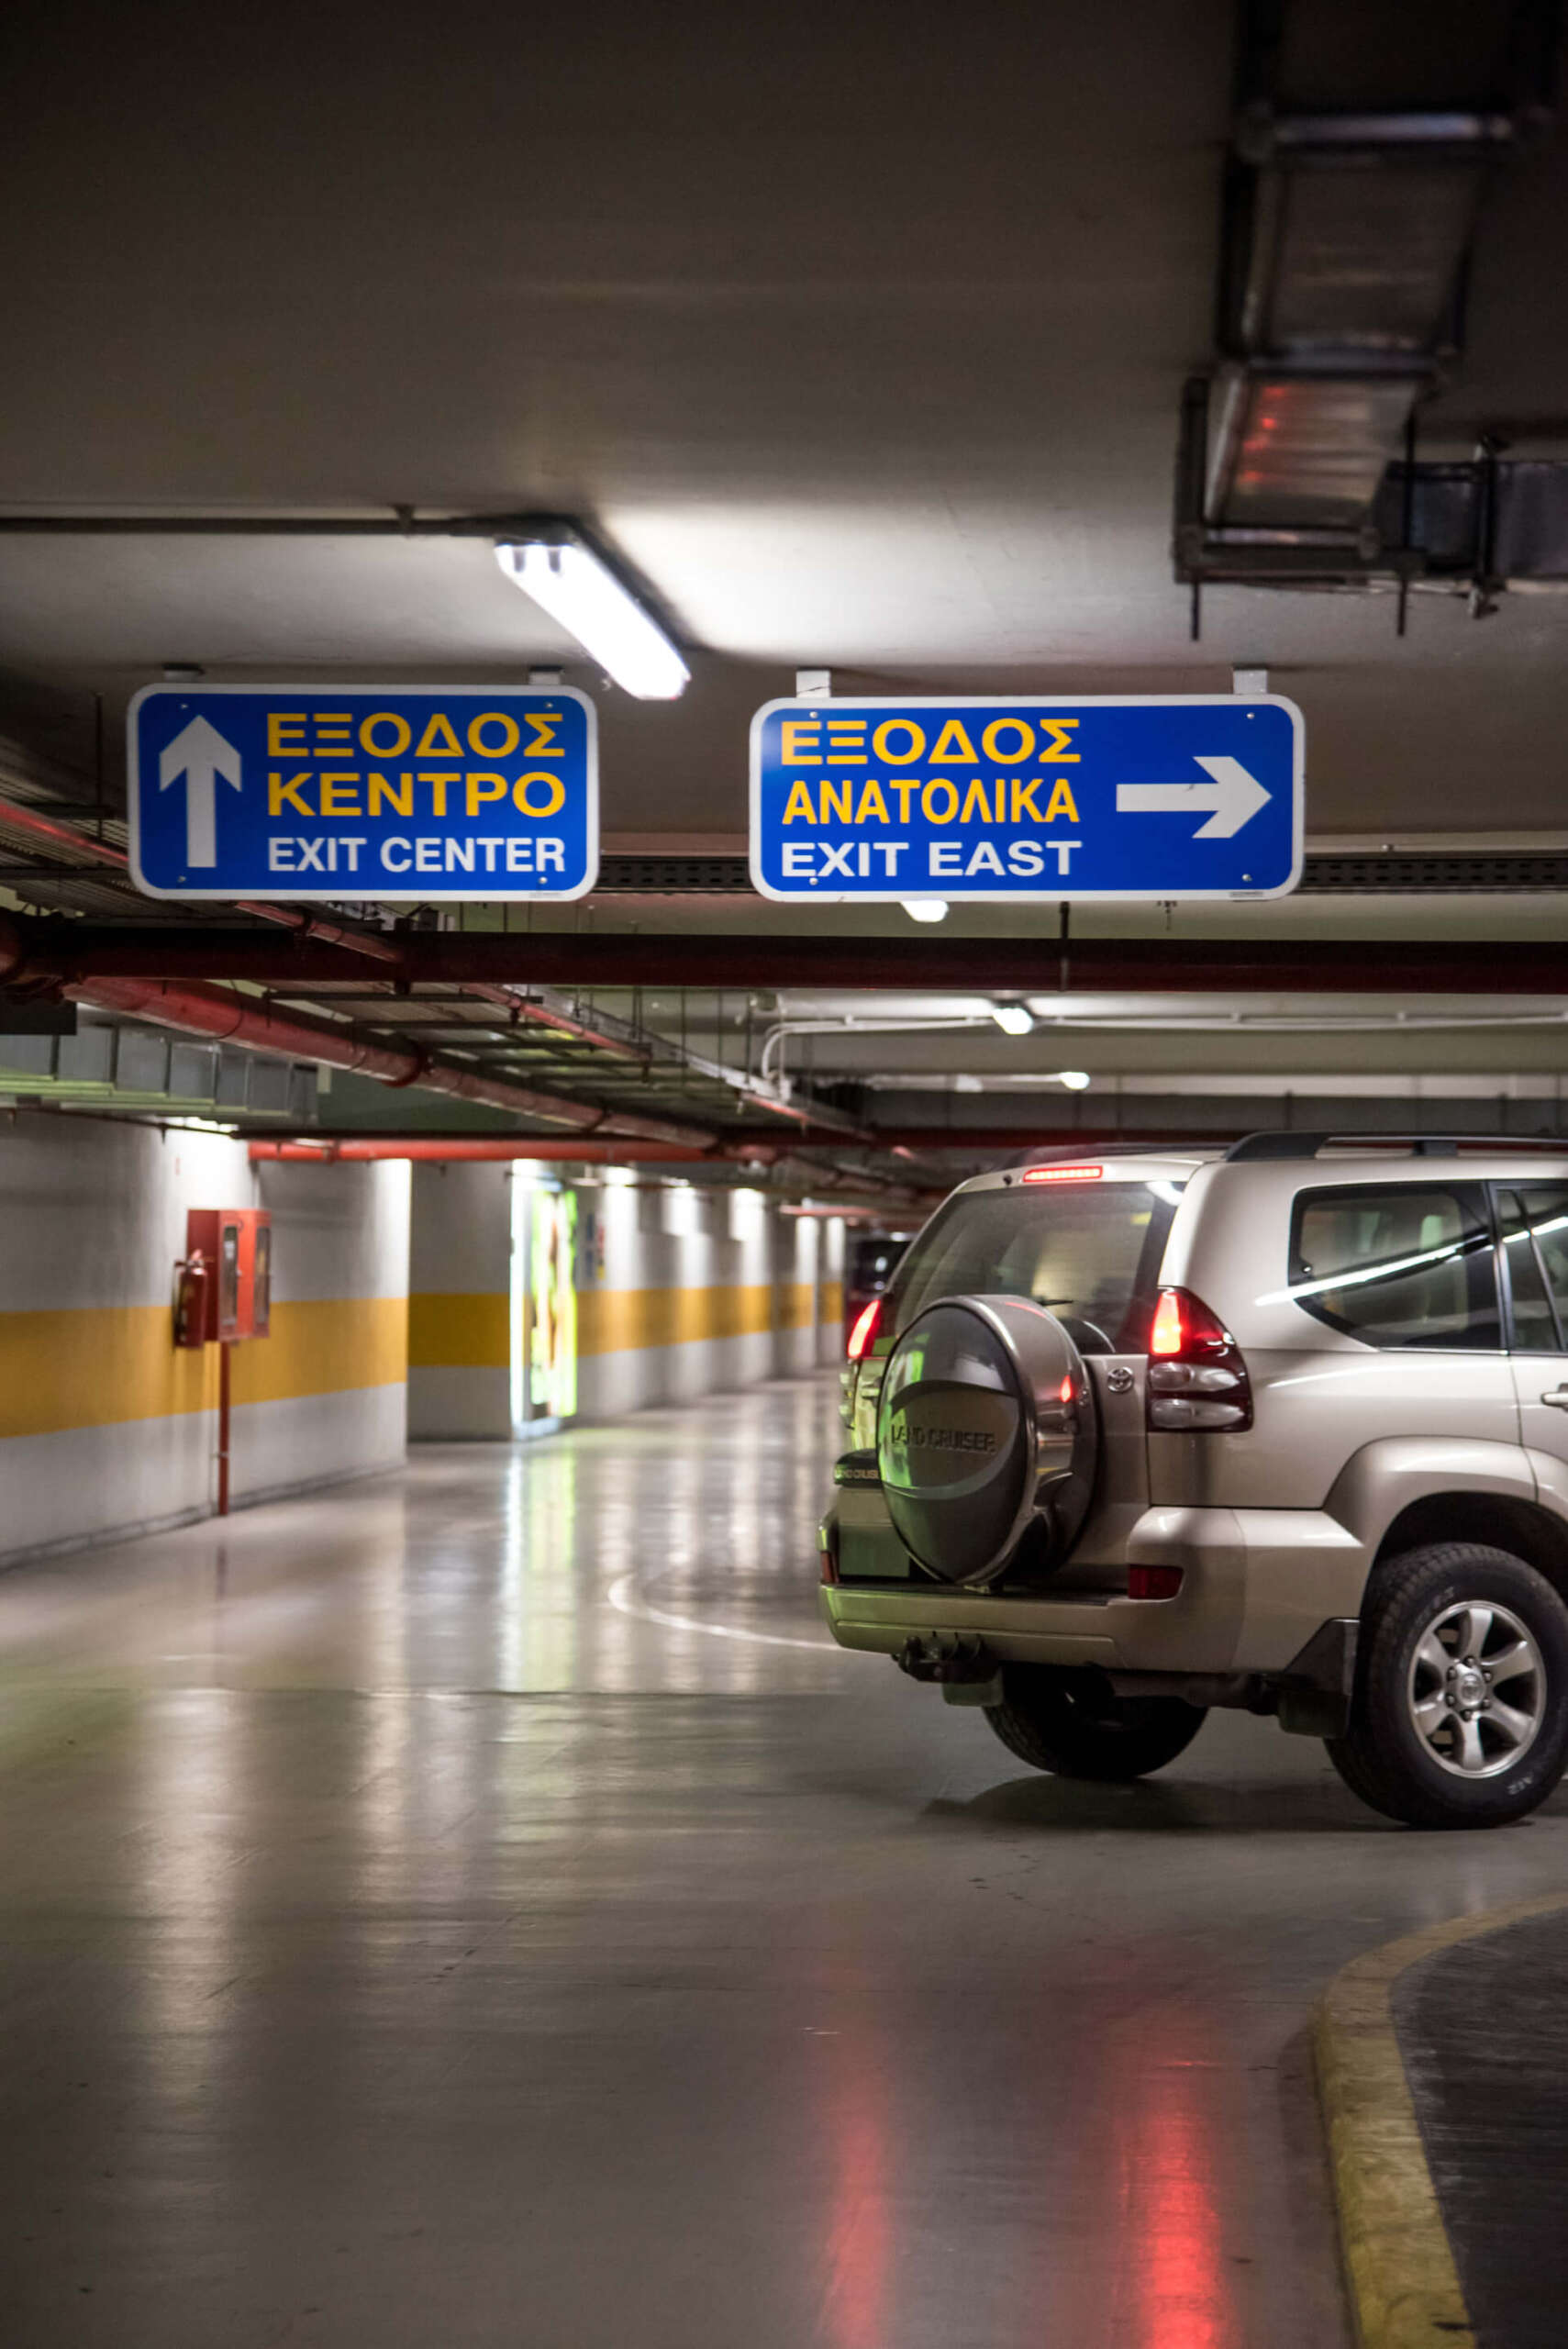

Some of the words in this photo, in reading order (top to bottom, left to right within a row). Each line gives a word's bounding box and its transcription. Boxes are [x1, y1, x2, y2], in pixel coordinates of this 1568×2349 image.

[268, 712, 565, 758] ΕΞΟΔΟΣ
[781, 718, 1082, 765] ΕΞΟΔΟΣ
[268, 771, 566, 818] ΚΕΝΤΡΟ
[782, 777, 1080, 826] ΑΝΑΤΟΛΙΚΑ
[269, 837, 367, 872] EXIT
[381, 837, 565, 873] CENTER
[782, 841, 909, 877] EXIT
[929, 841, 1083, 877] EAST
[929, 1428, 997, 1453] CRUISER
